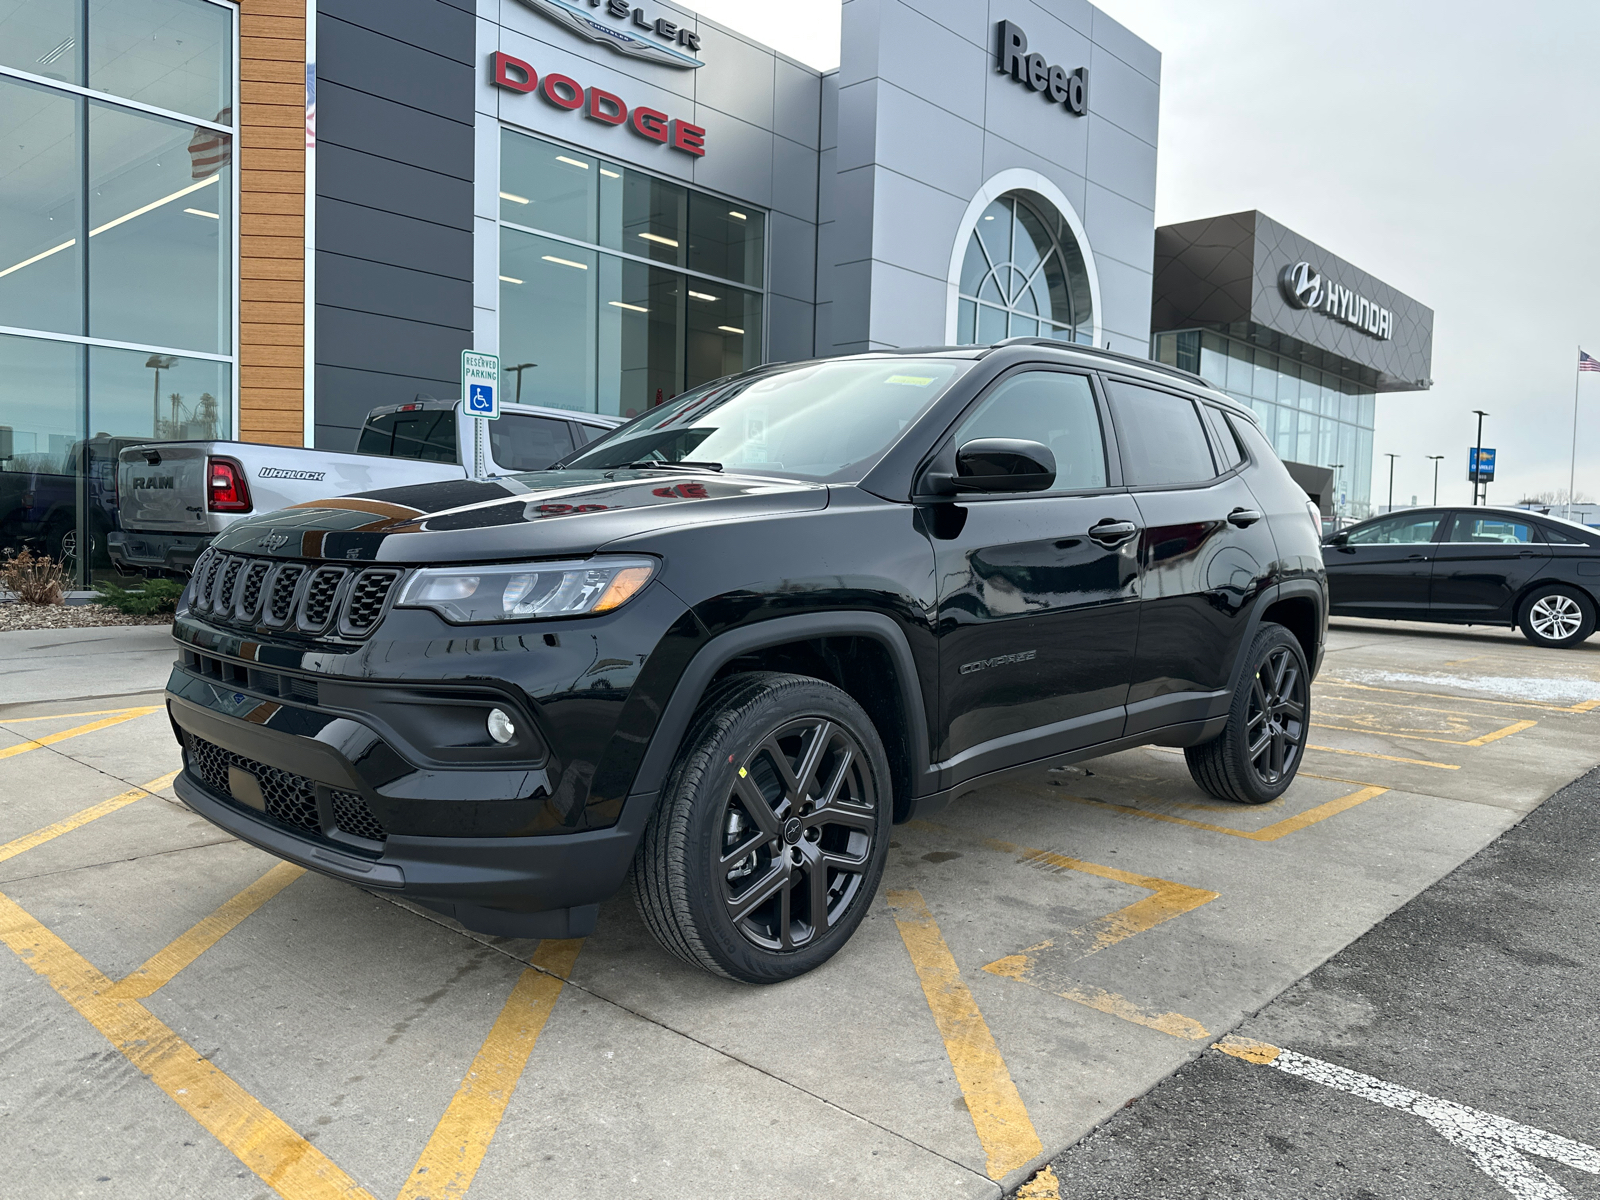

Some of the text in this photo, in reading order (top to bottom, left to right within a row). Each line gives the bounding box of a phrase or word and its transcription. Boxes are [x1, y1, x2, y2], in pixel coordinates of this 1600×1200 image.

[588, 0, 701, 51] SLER
[997, 19, 1089, 117] Reed
[490, 51, 705, 157] DODGE
[1326, 280, 1392, 341] HYUNDAI
[466, 357, 497, 370] RESERVED
[466, 368, 497, 381] PARKING
[133, 476, 174, 490] RAM
[258, 467, 326, 481] WARLOCK
